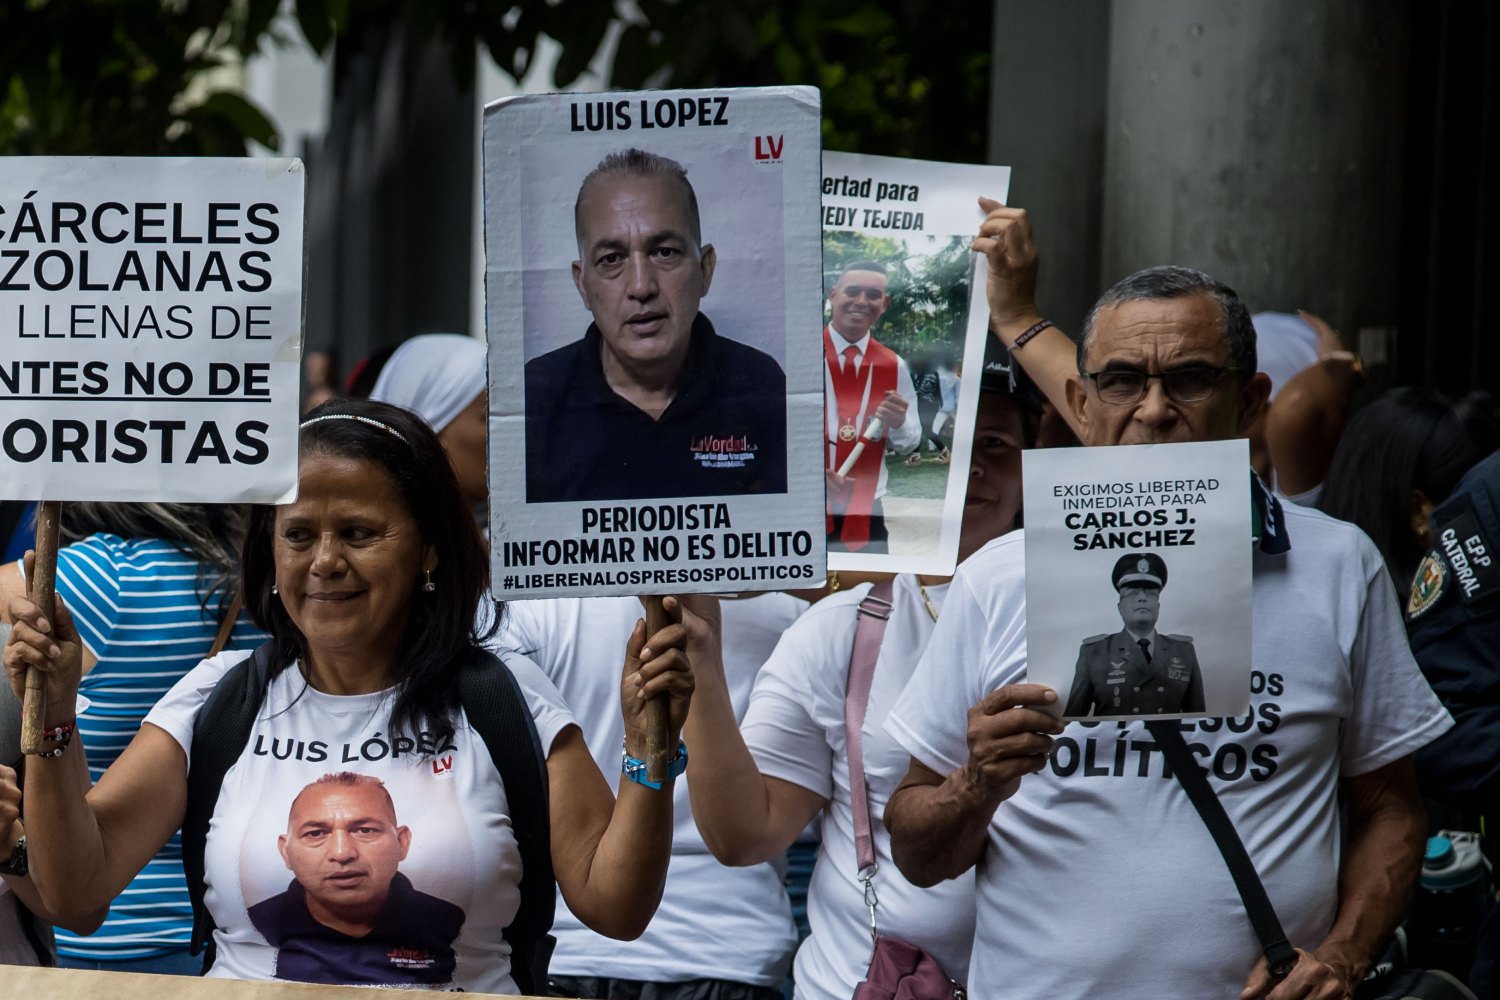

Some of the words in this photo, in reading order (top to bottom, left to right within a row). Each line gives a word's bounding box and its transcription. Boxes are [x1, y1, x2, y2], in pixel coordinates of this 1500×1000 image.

[571, 99, 631, 132] LUIS
[641, 96, 729, 129] LOPEZ
[755, 134, 784, 160] LV
[876, 180, 920, 202] para
[822, 205, 858, 229] EDY
[863, 208, 924, 231] TEJEDA
[18, 303, 193, 340] LLENAS
[211, 305, 272, 340] DE
[124, 361, 194, 396] NO
[209, 362, 271, 396] DE
[1053, 481, 1134, 498] EXIGIMOS
[1139, 478, 1220, 494] LIBERTAD
[1062, 494, 1155, 510] INMEDIATA
[1161, 492, 1207, 506] PARA
[582, 503, 731, 533] PERIODISTA
[1065, 509, 1168, 530] CARLOS
[1174, 508, 1197, 525] J.
[503, 537, 635, 568] INFORMAR
[643, 535, 680, 563] NO
[688, 533, 716, 560] ES
[723, 530, 813, 559] DELITO
[1073, 528, 1196, 551] SÁNCHEZ
[1441, 528, 1480, 598] CATEDRAL
[503, 564, 814, 590] #LIBERENALOSPRESOSPOLITICOS
[253, 734, 329, 763] LUIS
[432, 755, 453, 774] LV
